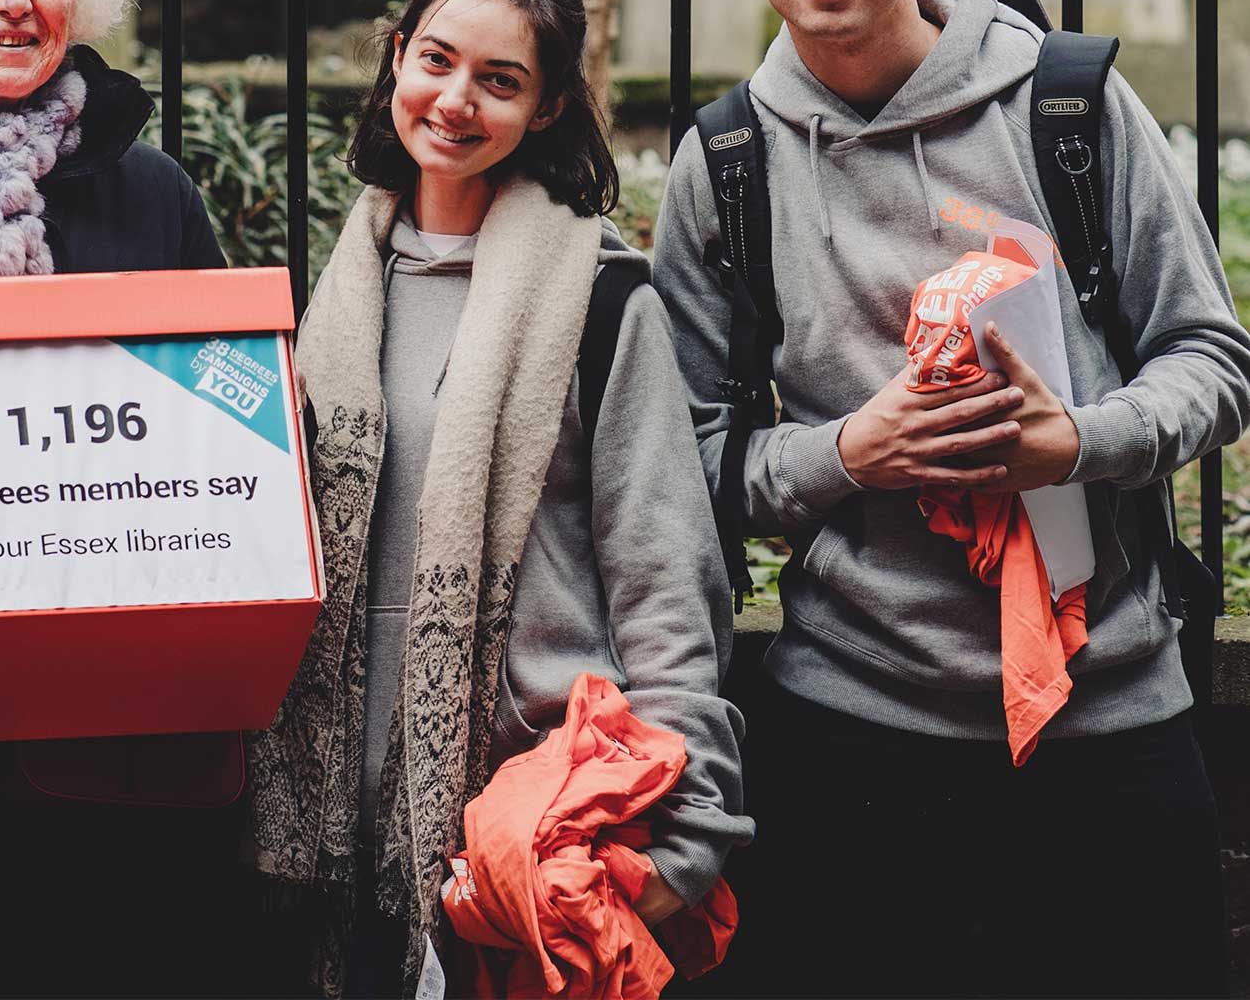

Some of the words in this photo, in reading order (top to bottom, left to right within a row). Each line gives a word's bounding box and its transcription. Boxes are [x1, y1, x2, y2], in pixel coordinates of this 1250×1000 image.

[960, 264, 1006, 319] chang
[190, 357, 207, 375] by
[210, 371, 256, 411] YOU
[197, 348, 270, 398] CAMPAIGNS
[206, 336, 230, 357] 38
[229, 347, 279, 384] DEGREES
[59, 473, 199, 502] members
[208, 474, 259, 501] say
[41, 532, 119, 557] Essex
[127, 528, 232, 554] libraries
